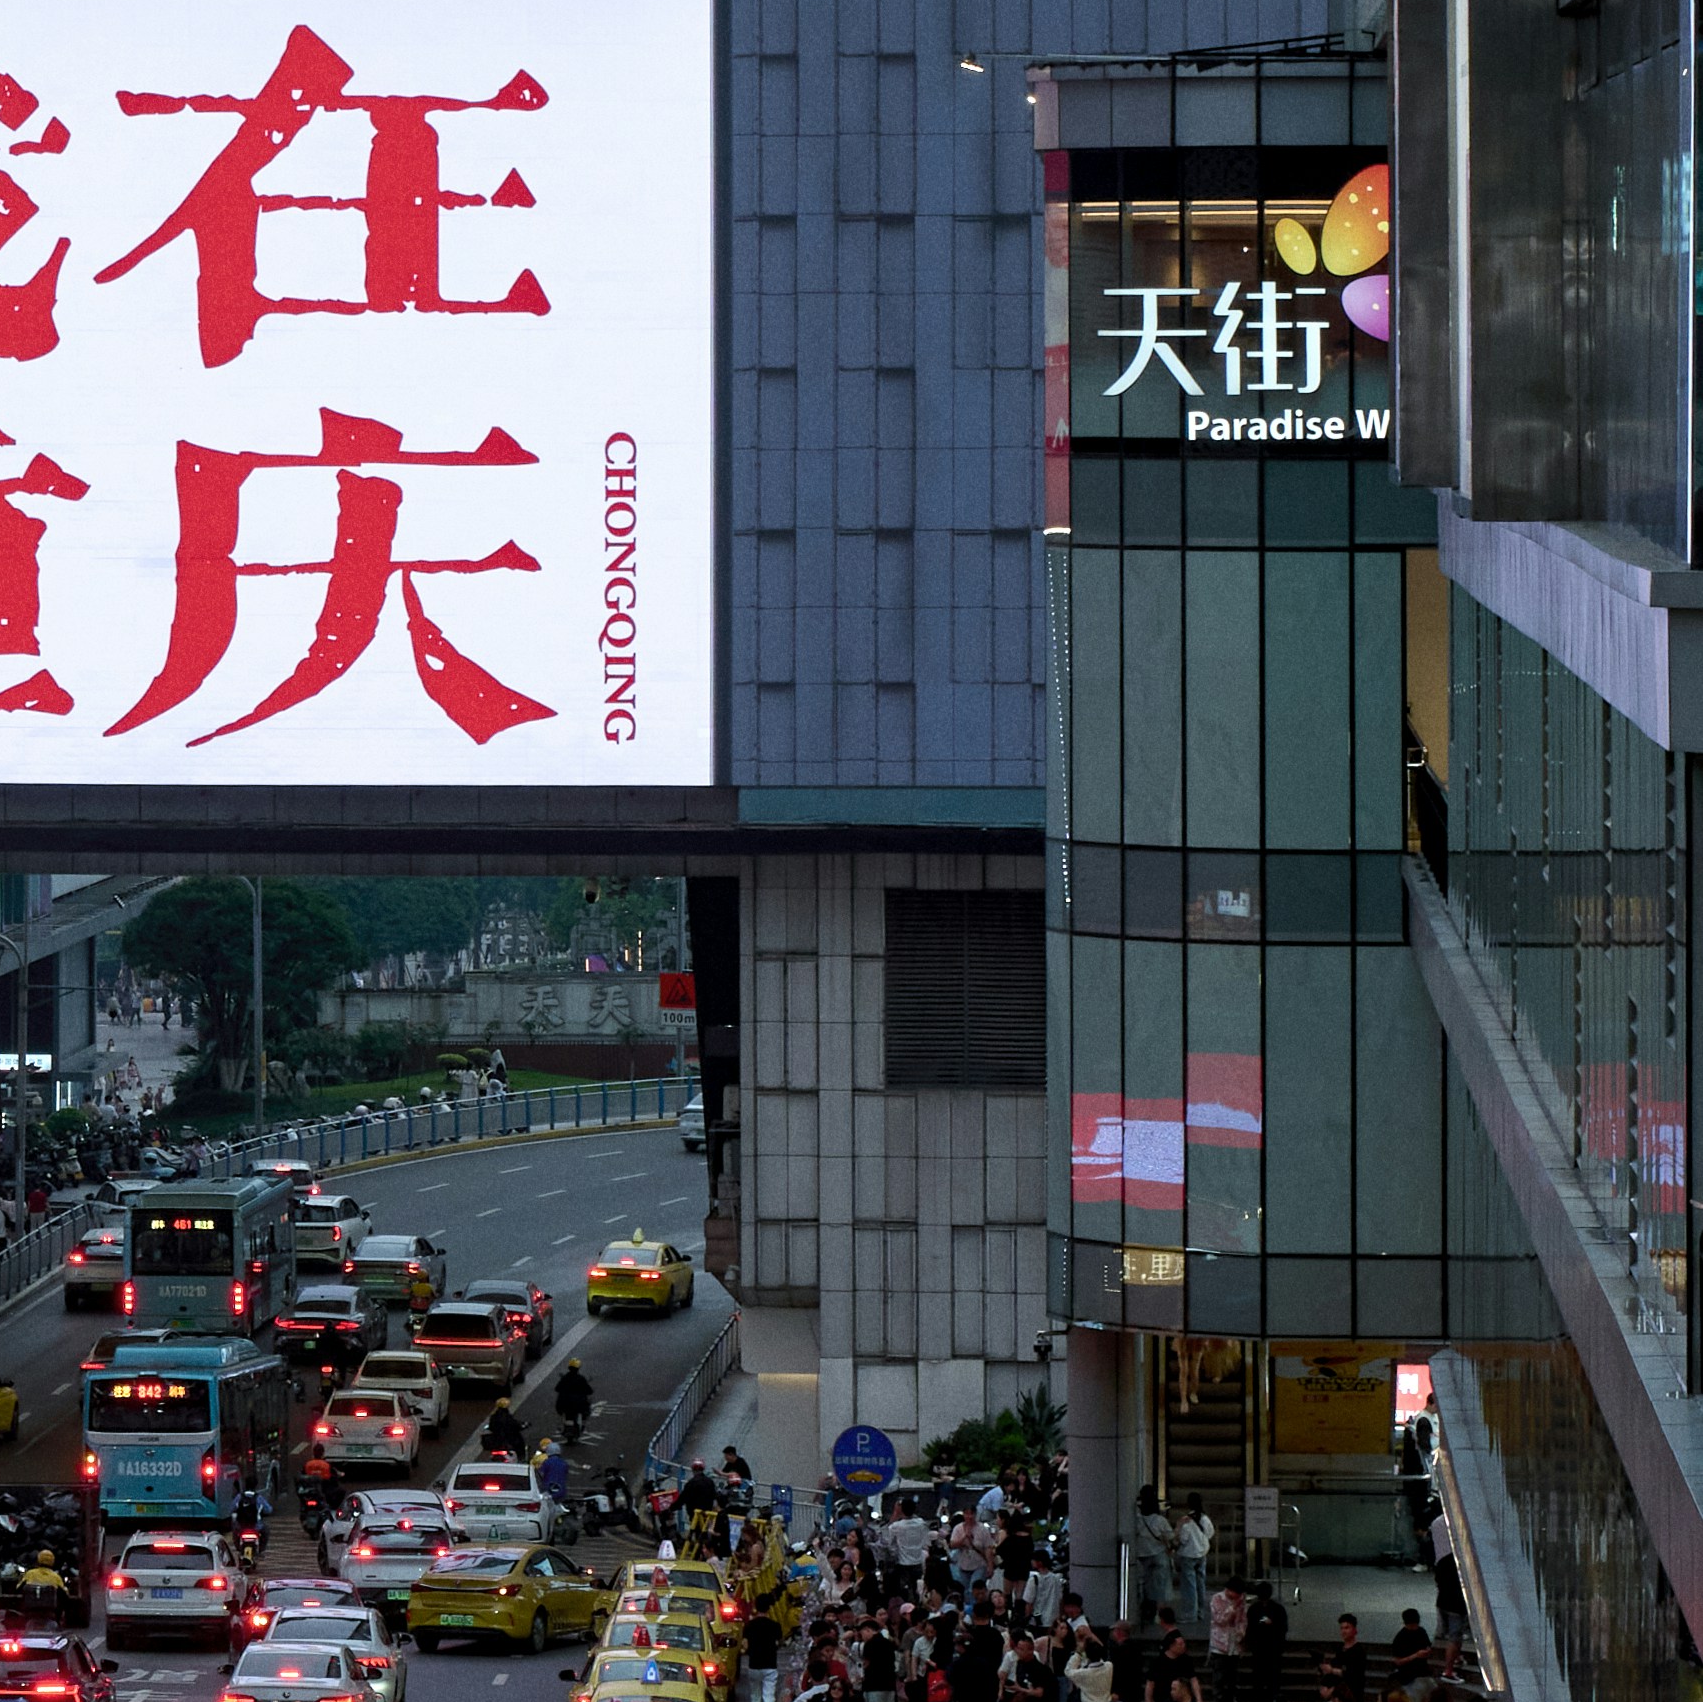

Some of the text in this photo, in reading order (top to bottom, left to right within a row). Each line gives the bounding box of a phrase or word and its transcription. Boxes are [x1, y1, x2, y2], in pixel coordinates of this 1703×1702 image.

[1097, 281, 1330, 396] 天街
[1187, 409, 1345, 441] Paradise
[603, 431, 638, 746] CHONGQING
[661, 1012, 695, 1026] 100m
[138, 1385, 162, 1399] 842
[857, 1433, 870, 1453] P
